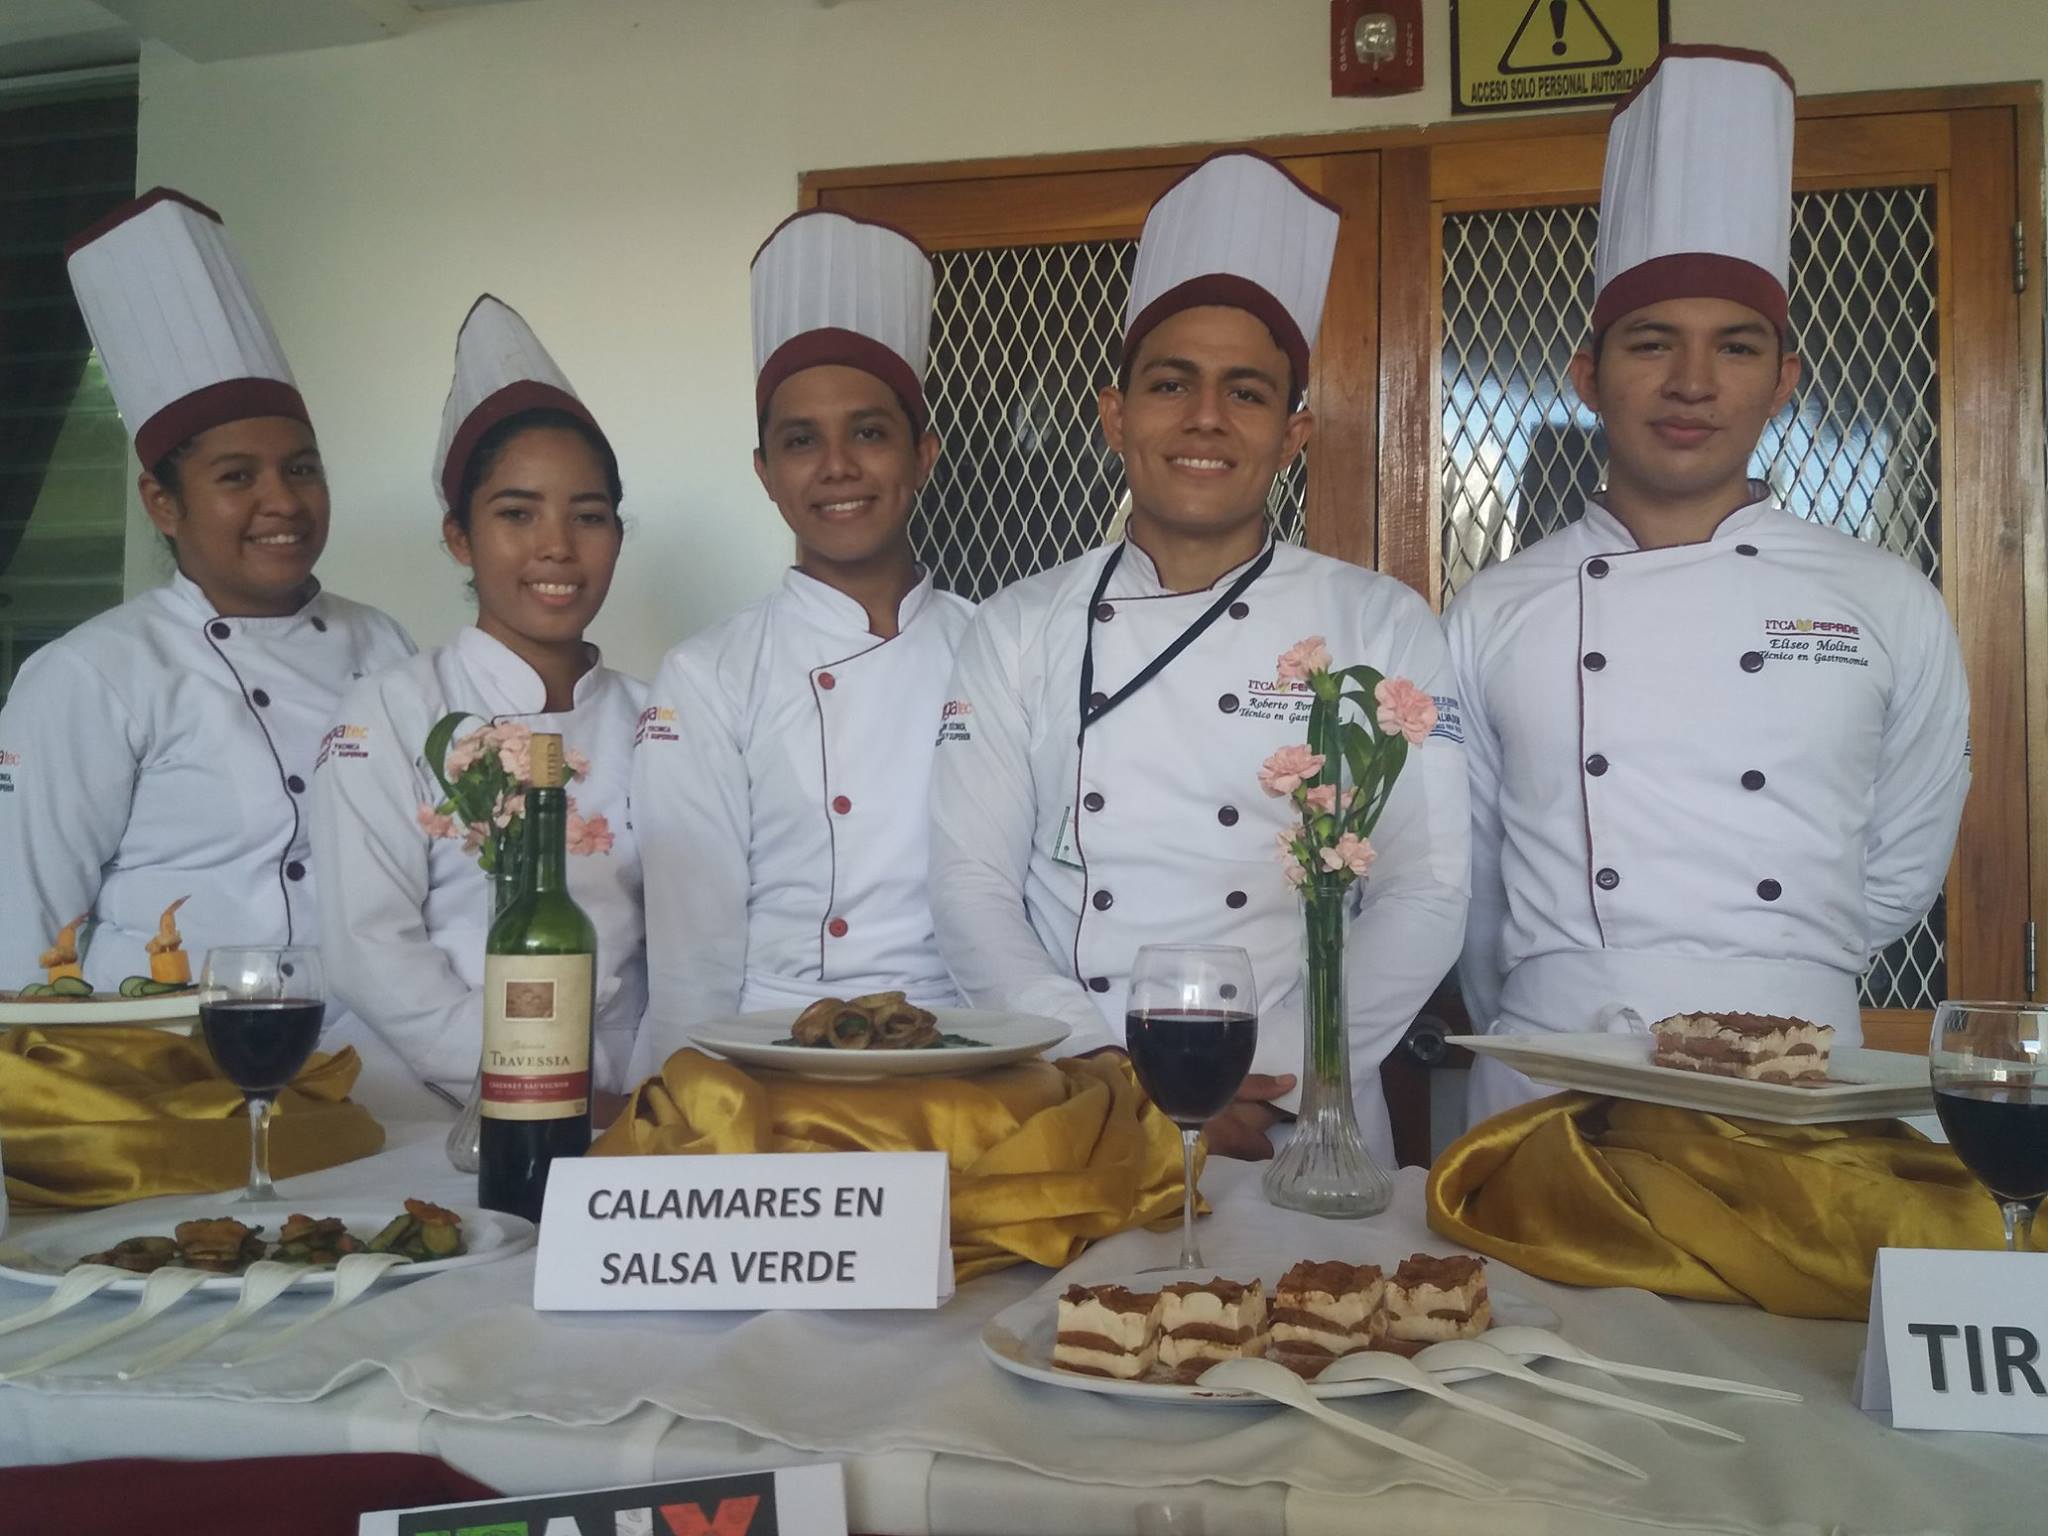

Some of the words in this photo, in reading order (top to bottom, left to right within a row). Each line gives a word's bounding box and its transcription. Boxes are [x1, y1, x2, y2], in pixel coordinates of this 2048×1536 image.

[1471, 80, 1508, 103] ACCESO
[1510, 77, 1536, 100] SOLO
[1538, 72, 1588, 97] PERSONAL
[1765, 619, 1797, 631] ITCA
[1812, 621, 1860, 635] FEPADE
[1816, 639, 1859, 653] Molina
[1797, 653, 1809, 661] en
[1248, 680, 1276, 691] ITCA
[1249, 698, 1289, 710] Roberto
[489, 1050, 571, 1067] TRAVESSIA
[588, 1187, 821, 1219] CALAMARES
[834, 1187, 884, 1217] EN
[600, 1252, 717, 1285] SALSA
[730, 1250, 857, 1283] VERDE
